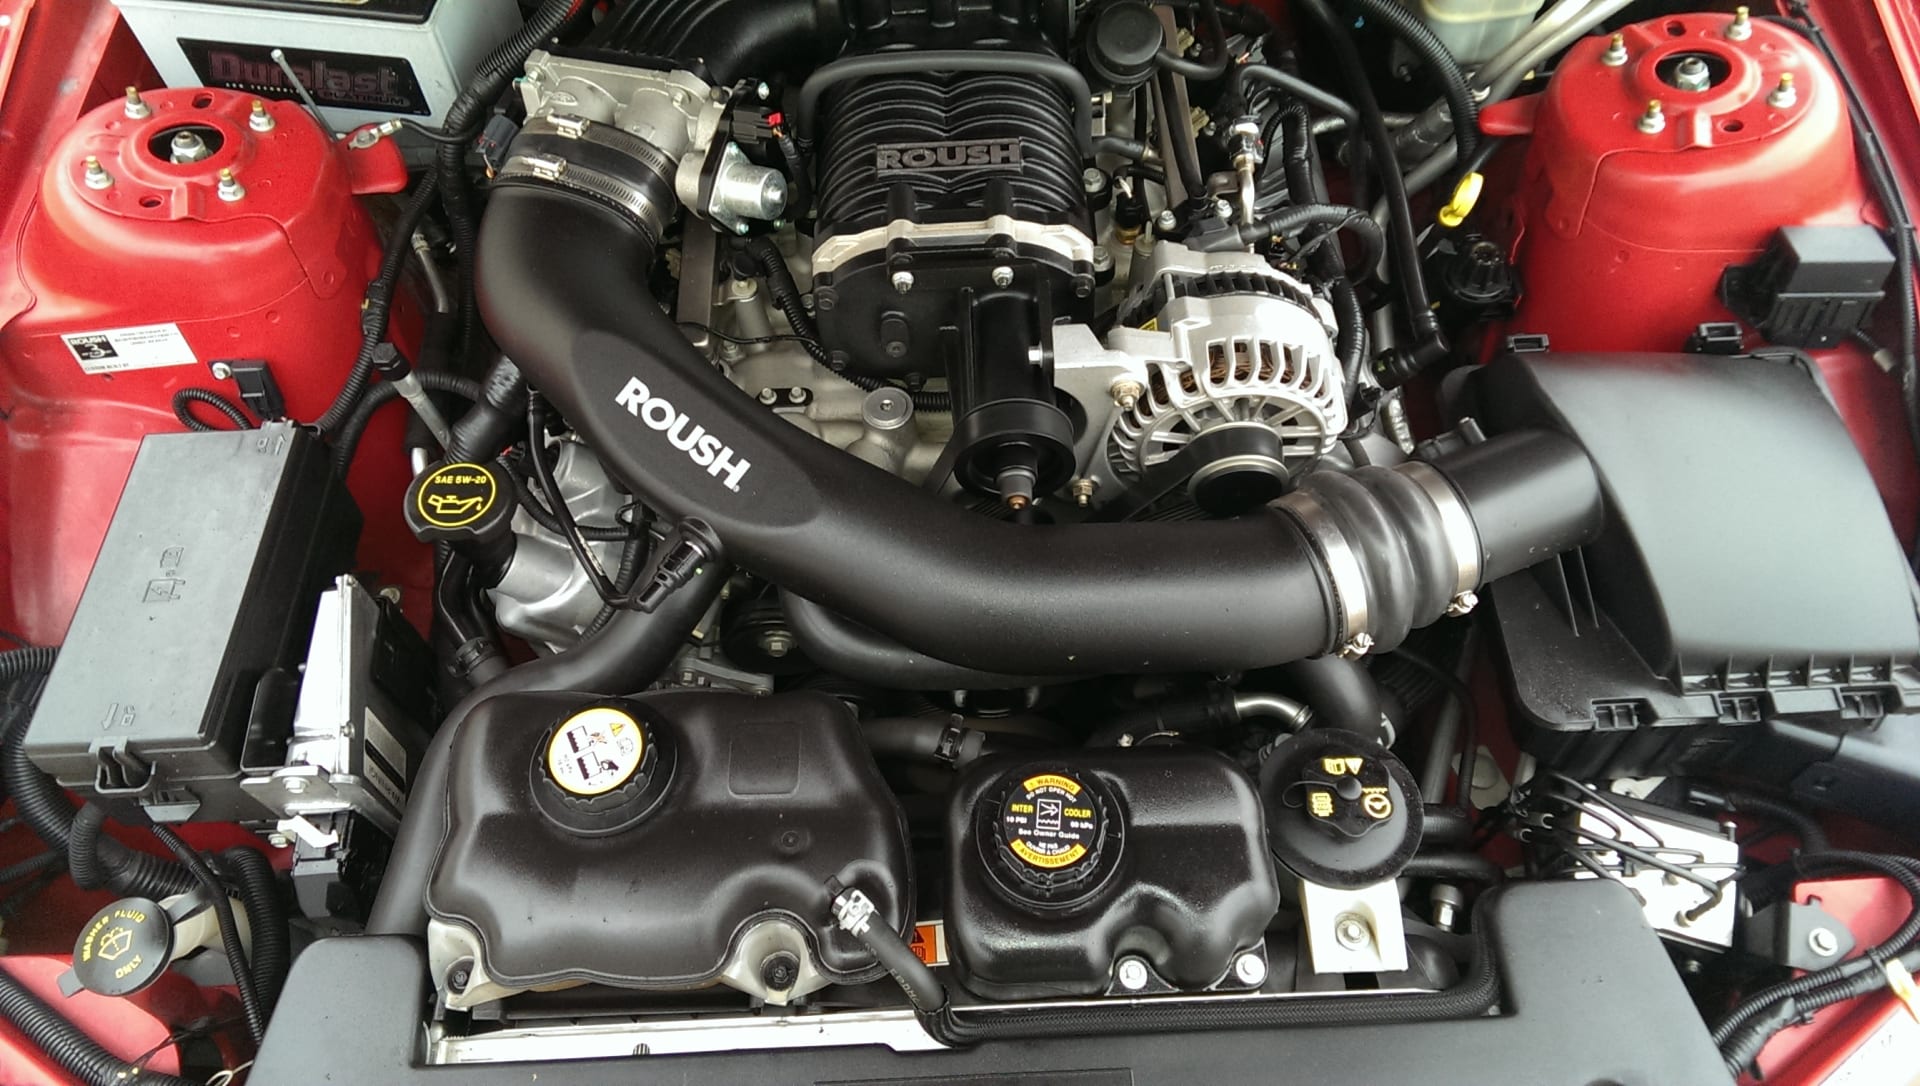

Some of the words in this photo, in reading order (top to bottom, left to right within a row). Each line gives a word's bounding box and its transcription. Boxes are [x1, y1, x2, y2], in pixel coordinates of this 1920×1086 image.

[876, 143, 1020, 169] ROUSH
[69, 335, 107, 346] ROUSH
[614, 376, 751, 491] ROUSH
[434, 475, 454, 484] SAE
[1035, 786, 1047, 795] NOT
[1048, 786, 1065, 795] OPEN
[1037, 777, 1076, 791] WARNING
[1011, 803, 1034, 814] INTER
[1063, 807, 1092, 818] COOLER
[1018, 828, 1032, 836] See
[1033, 829, 1057, 838] Owner
[1058, 831, 1080, 840] Guide
[1019, 847, 1080, 865] AVERTISSEMENT
[82, 915, 110, 962] WASHER
[114, 909, 146, 923] FLUID
[115, 953, 142, 979] ONLY
